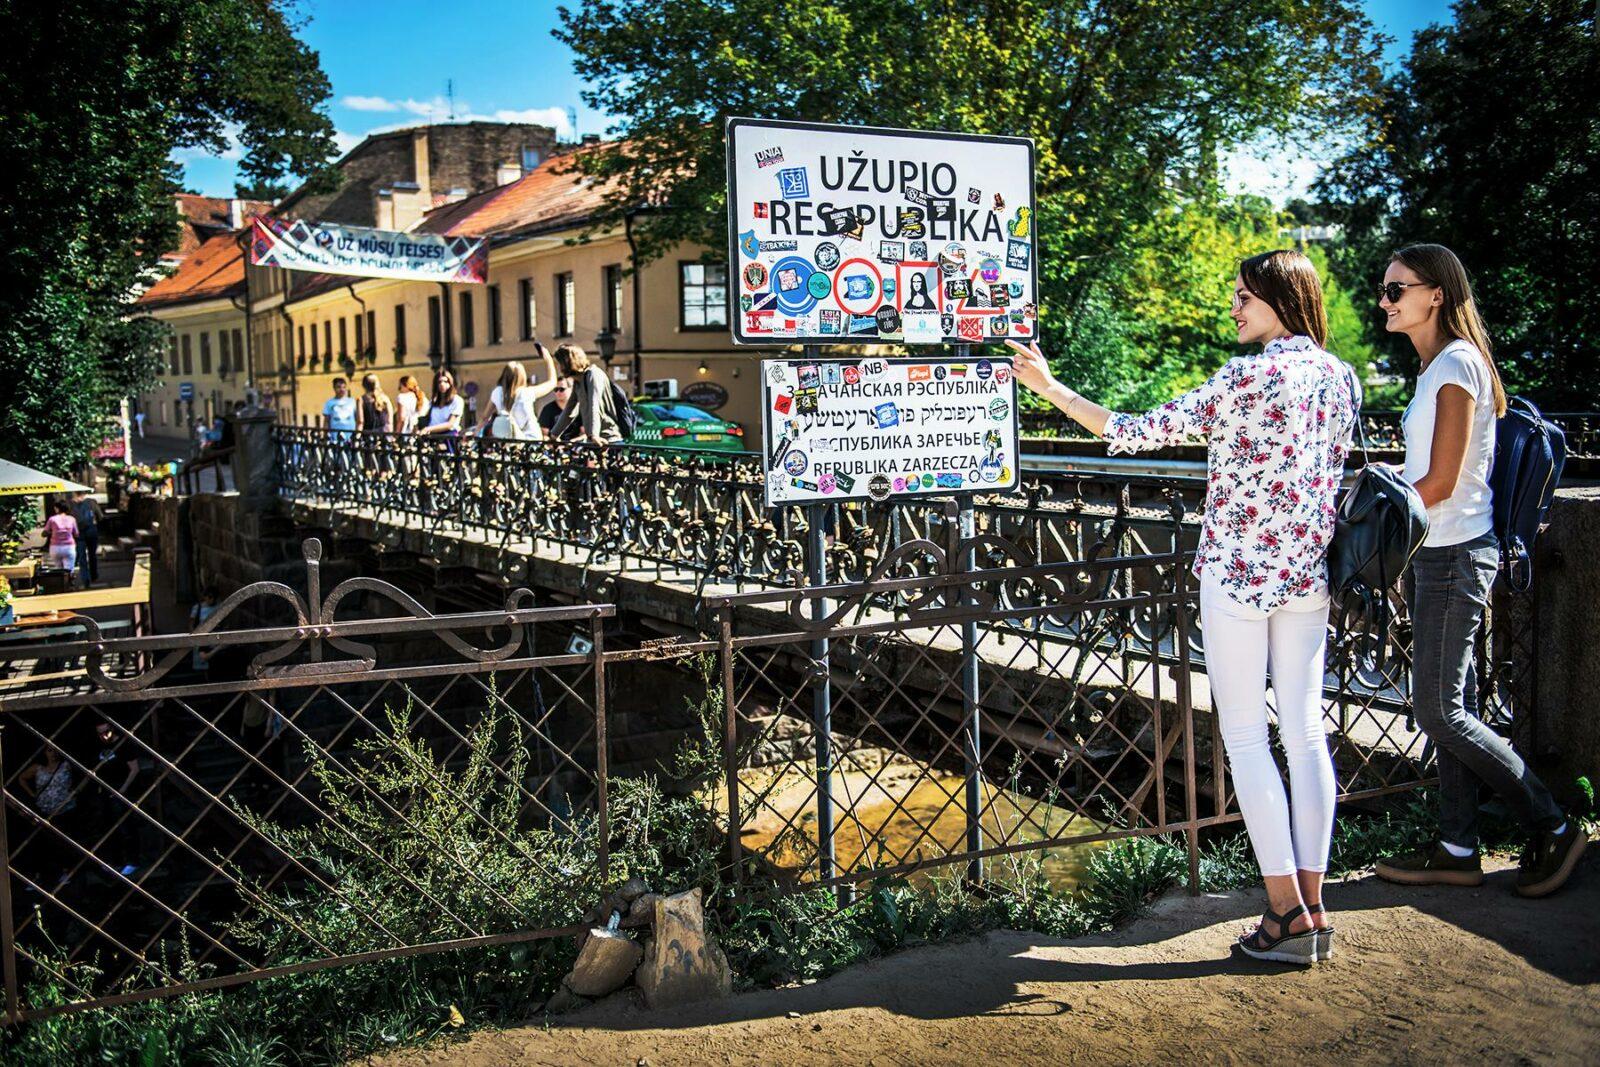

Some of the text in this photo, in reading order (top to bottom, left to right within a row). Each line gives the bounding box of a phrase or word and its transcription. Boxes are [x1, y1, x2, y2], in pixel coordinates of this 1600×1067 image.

[820, 150, 957, 196] UŽUPIO
[864, 362, 883, 376] NB
[786, 380, 998, 398] ЗАЧАНСКАЯ РЭСПУБЛІКА
[809, 432, 980, 453] СПУБЛИКА ЗАРЕЧЬЕ
[814, 455, 978, 477] REPUBLIKA ZARZECZA
